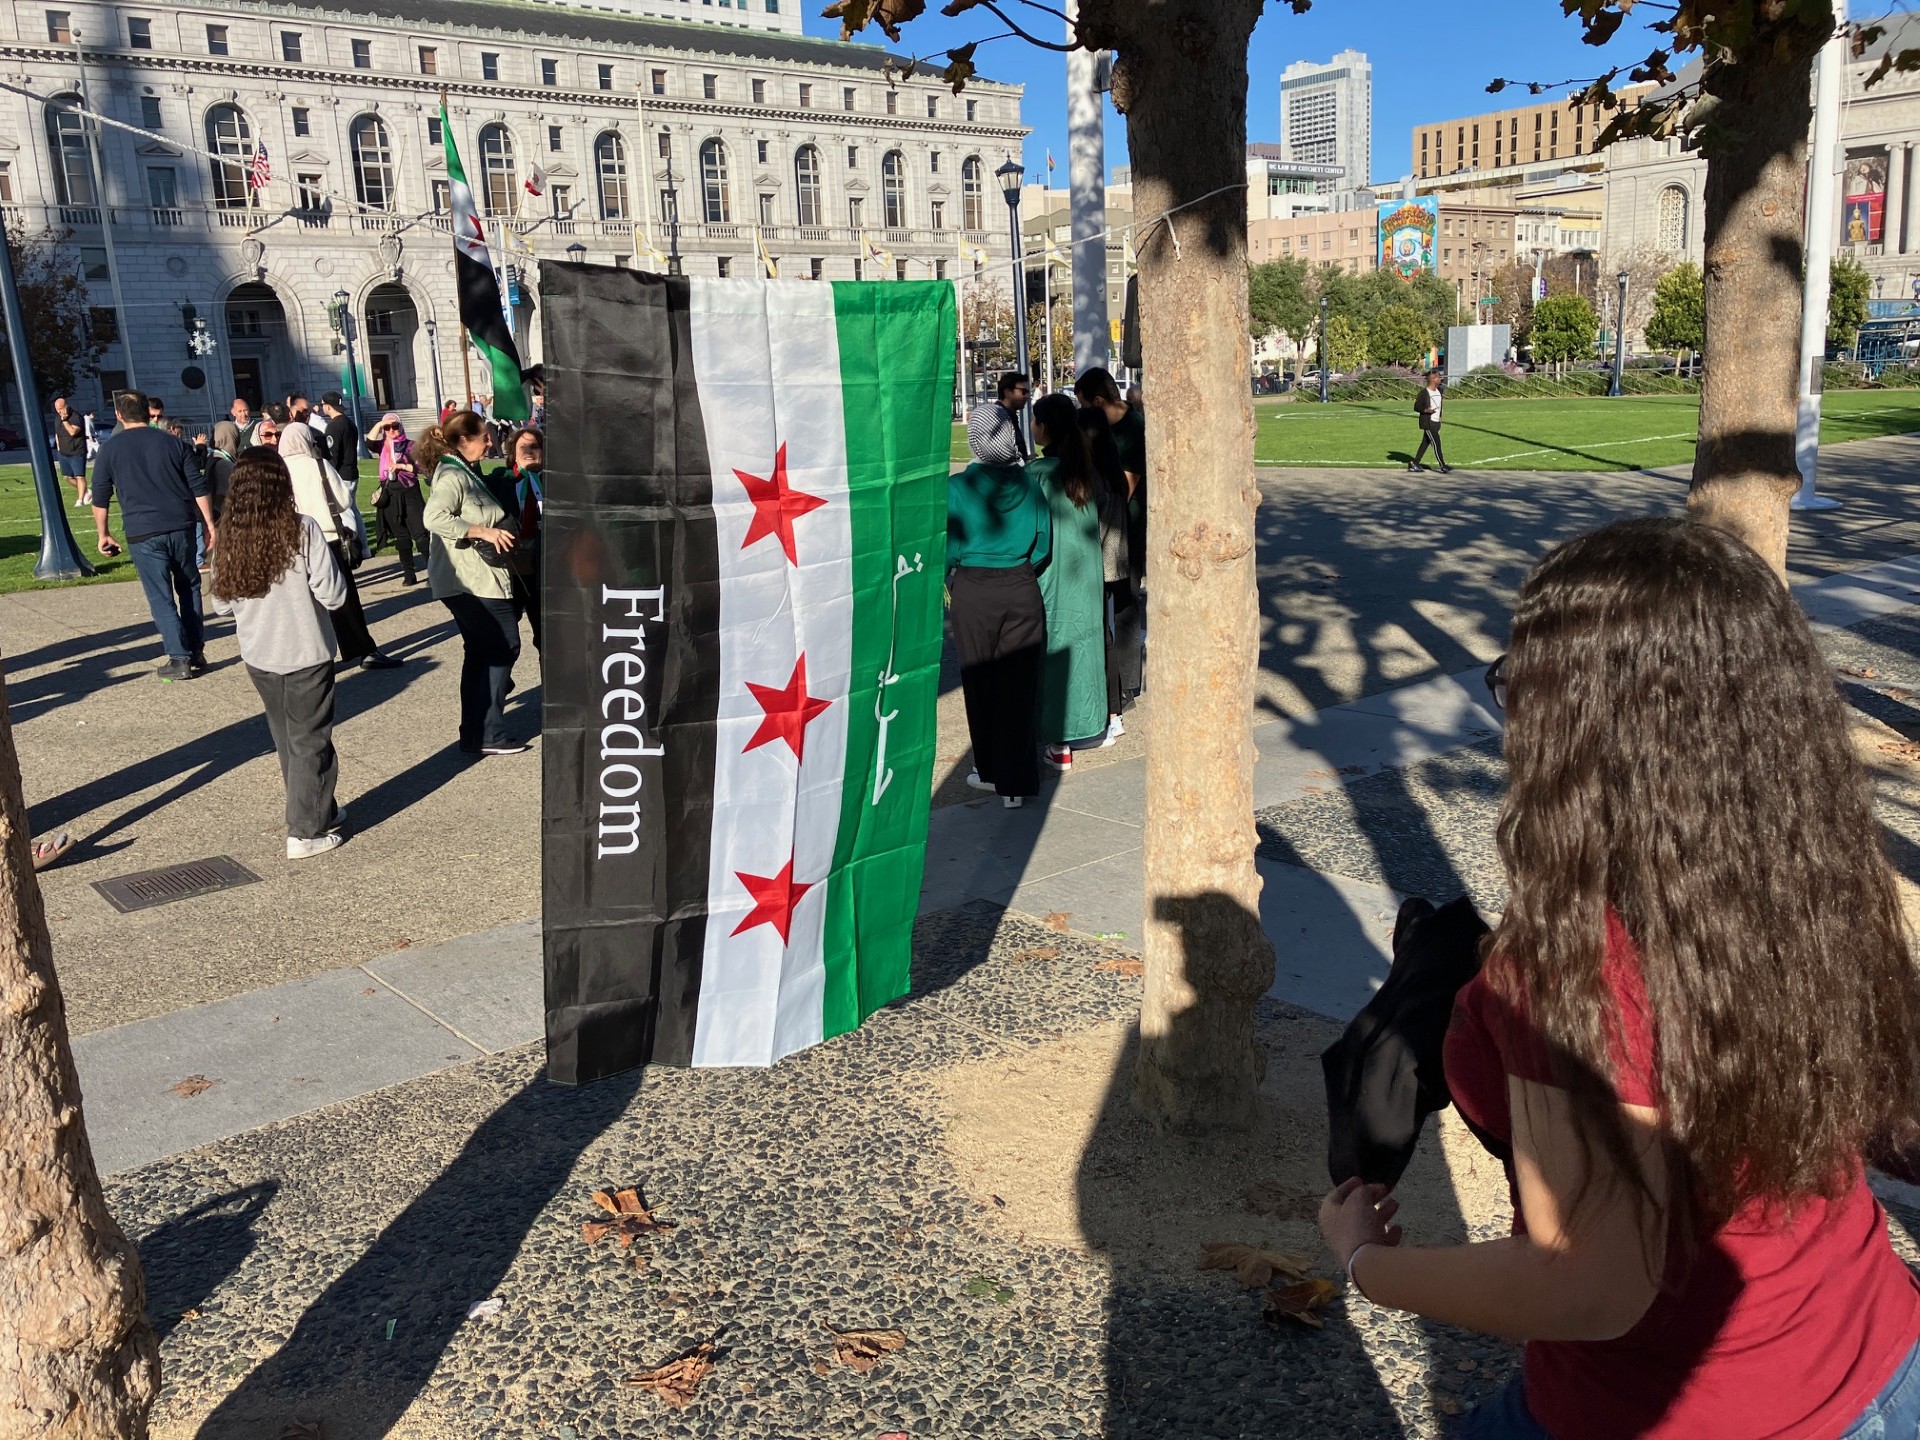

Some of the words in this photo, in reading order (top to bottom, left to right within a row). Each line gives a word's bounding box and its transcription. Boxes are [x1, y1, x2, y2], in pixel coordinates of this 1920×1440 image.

[1324, 167, 1344, 175] CENTER
[598, 583, 665, 860] Freedom
[872, 552, 924, 806] حرية
